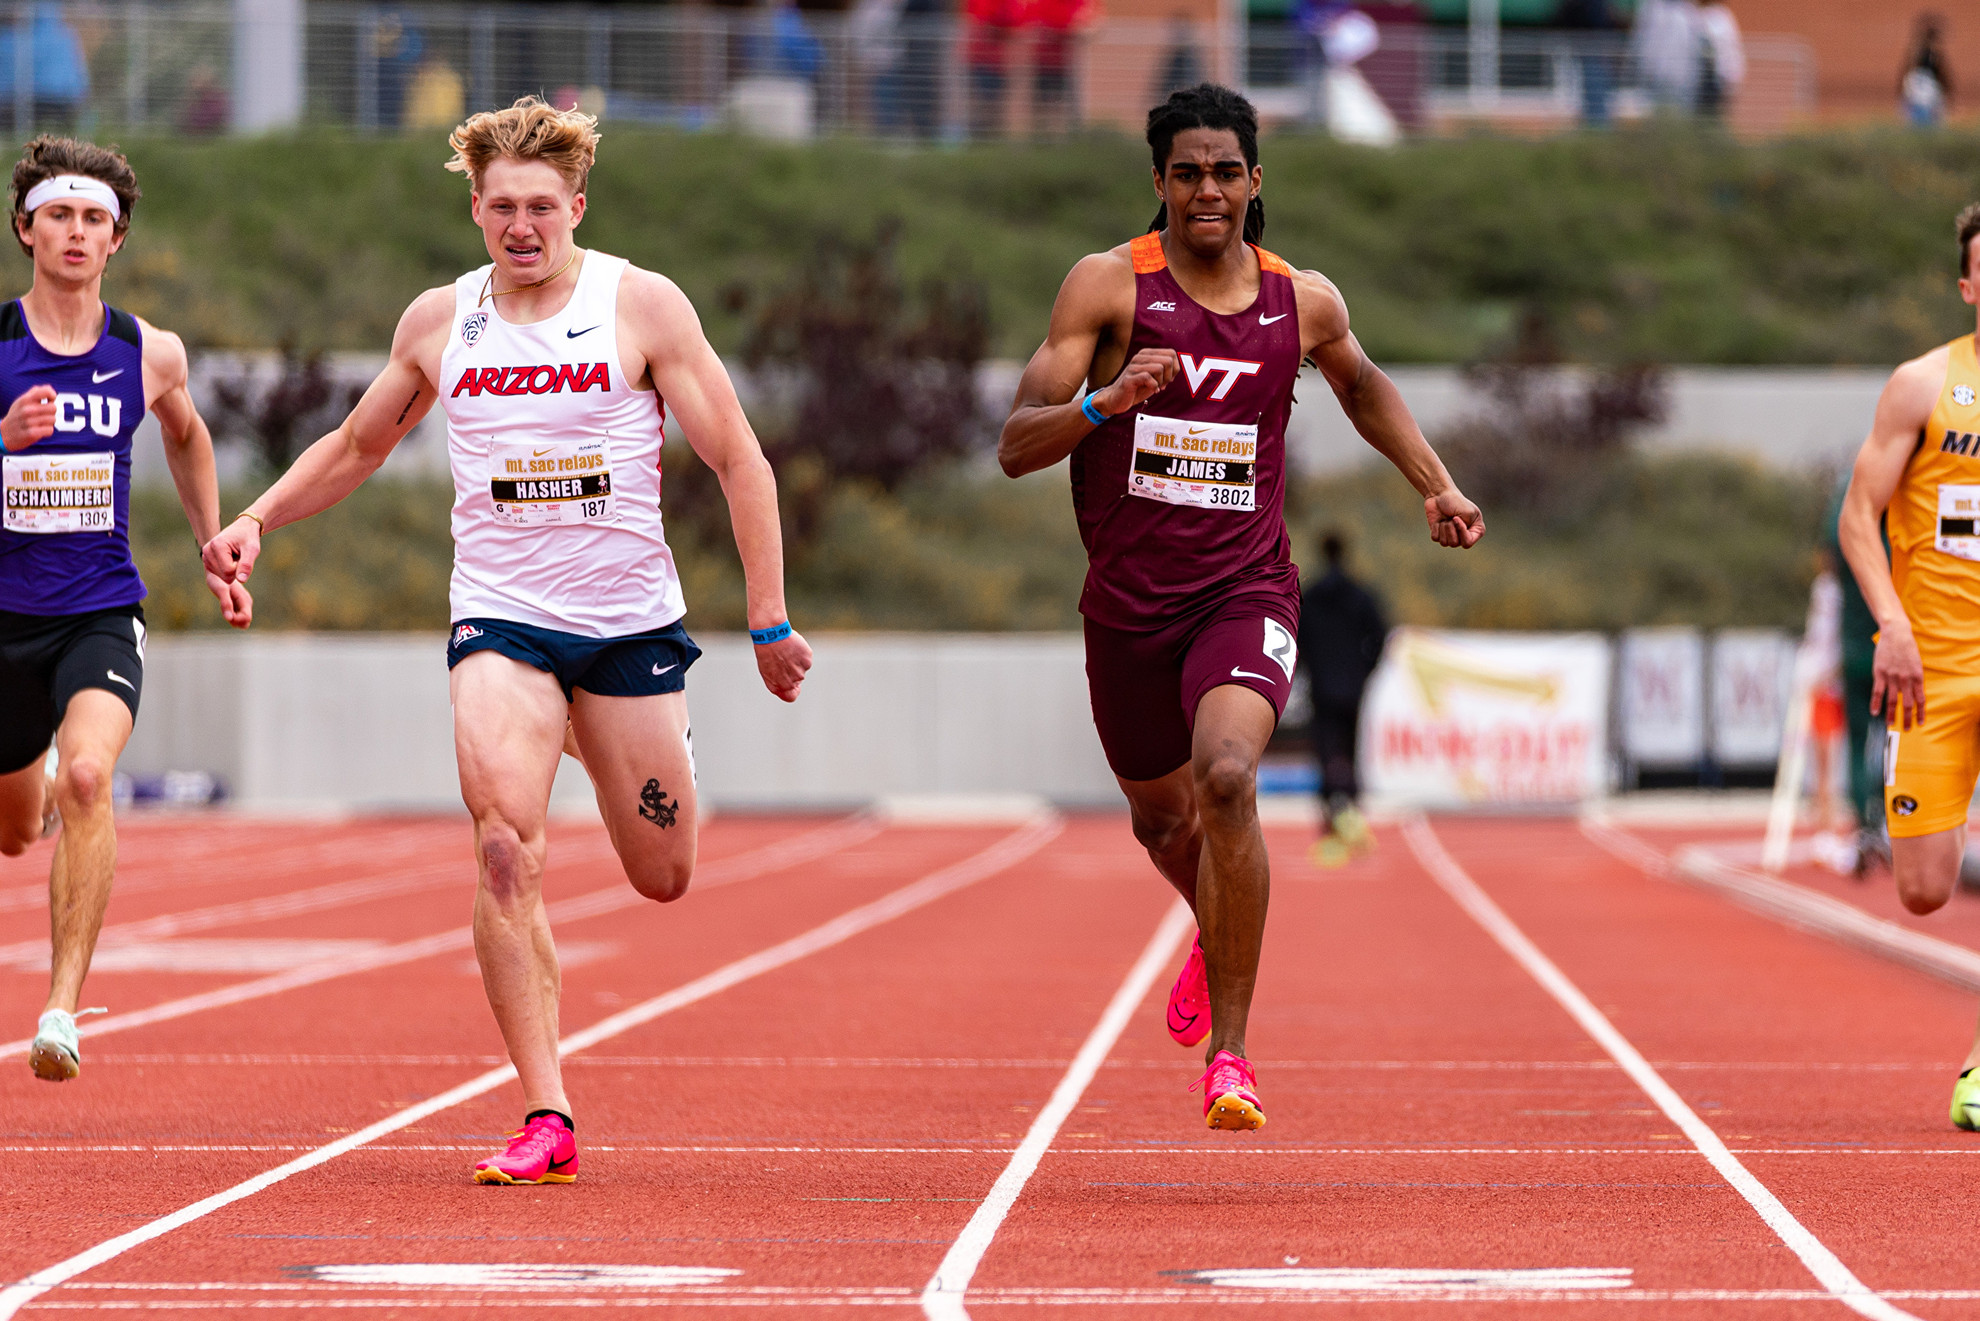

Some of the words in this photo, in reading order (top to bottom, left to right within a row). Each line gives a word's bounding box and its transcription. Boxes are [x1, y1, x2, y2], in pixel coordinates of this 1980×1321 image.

[1147, 301, 1176, 310] ACC
[466, 330, 478, 340] 12
[451, 363, 611, 398] ARIZONA
[1177, 352, 1264, 402] VT
[41, 393, 122, 438] CU
[1155, 432, 1178, 449] mt.
[1182, 436, 1208, 452] sac
[1212, 438, 1254, 456] relays
[505, 458, 527, 473] mt.
[530, 458, 555, 473] sac
[558, 453, 604, 471] relays
[1166, 459, 1227, 480] JAMES
[22, 469, 43, 482] mt.
[46, 469, 69, 482] sac
[72, 467, 110, 481] relays
[516, 479, 583, 499] HASHER
[1210, 487, 1250, 506] 3802
[581, 500, 606, 518] 187
[80, 512, 108, 527] 1309
[1272, 626, 1291, 672] 2
